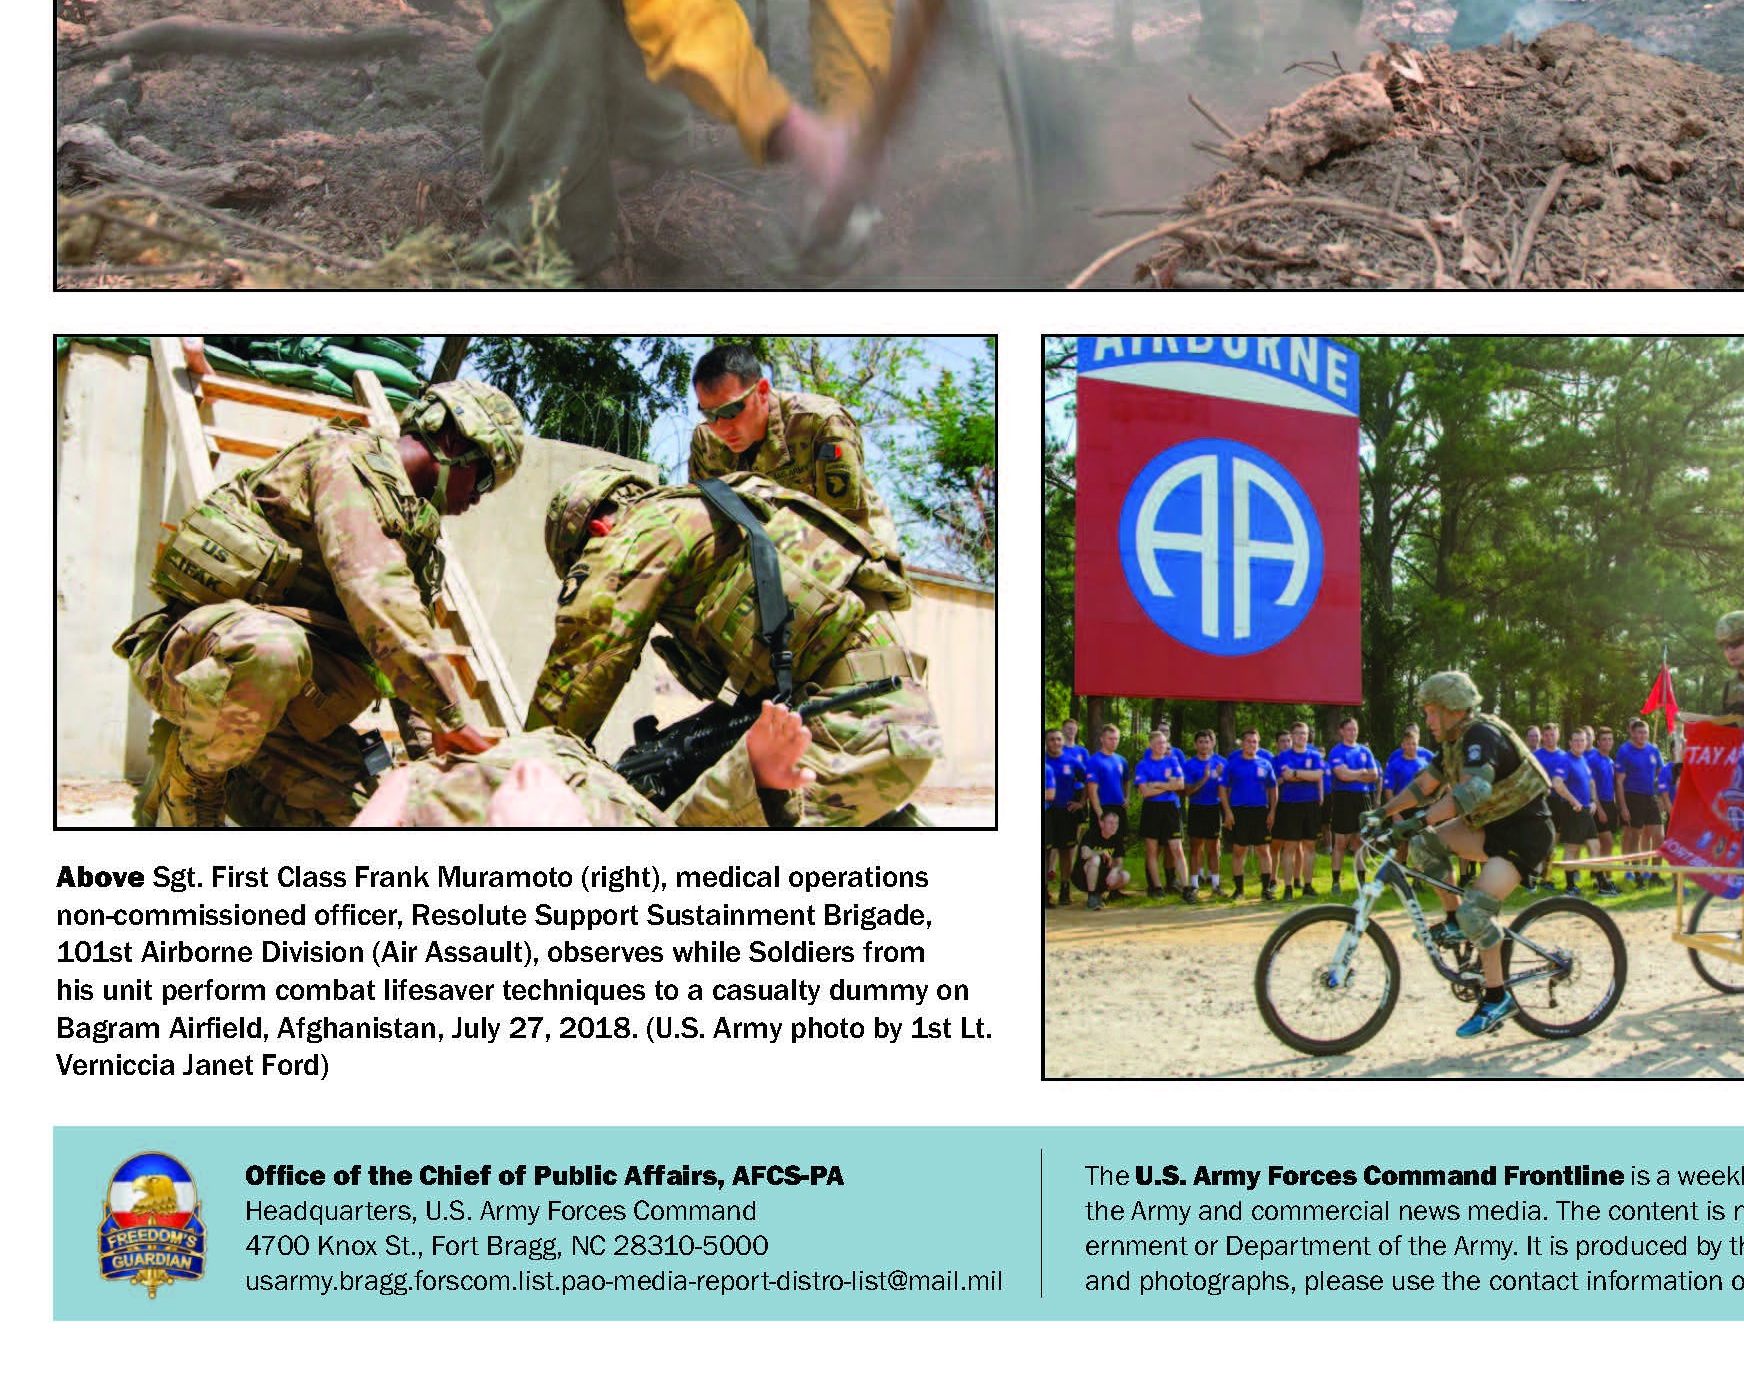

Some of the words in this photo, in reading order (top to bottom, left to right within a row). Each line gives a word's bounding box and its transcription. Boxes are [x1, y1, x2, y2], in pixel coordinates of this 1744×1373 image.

[200, 538, 229, 564] US
[55, 865, 145, 888] Above
[152, 865, 203, 893] Sgt.
[212, 865, 269, 888] First
[277, 865, 347, 888] Class
[355, 865, 430, 888] Frank
[438, 865, 573, 888] Muramoto
[581, 865, 667, 893] (right),
[676, 865, 780, 888] medical
[788, 865, 929, 893] operations
[245, 1164, 326, 1186] Office
[333, 1164, 362, 1186] of
[367, 1165, 413, 1186] the
[419, 1164, 492, 1186] Chief
[498, 1164, 527, 1186] of
[534, 1164, 618, 1186] Public
[623, 1164, 725, 1191] Affairs,
[731, 1164, 845, 1186] AFCS-PA
[1084, 1165, 1130, 1186] The
[1135, 1164, 1187, 1186] U.S.
[1192, 1165, 1262, 1191] Army
[1268, 1165, 1358, 1186] Forces
[1363, 1164, 1497, 1186] Command
[1504, 1164, 1625, 1186] Frontline
[1631, 1165, 1651, 1186] is
[1656, 1169, 1670, 1186] a
[246, 1200, 417, 1226] Headquarters,
[426, 1199, 472, 1221] U.S.
[479, 1200, 541, 1226] Army
[548, 1200, 627, 1221] Forces
[633, 1199, 756, 1221] Command
[107, 1228, 198, 1249] FREEDOM'S
[245, 1234, 310, 1256] 4700
[318, 1235, 378, 1256] Knox
[385, 1234, 423, 1260] St.,
[432, 1235, 480, 1256] Fort
[487, 1235, 562, 1261] Bragg,
[572, 1234, 606, 1256] NC
[613, 1234, 769, 1256] 28310-5000
[111, 1252, 193, 1270] GUARDIAN
[246, 1269, 1002, 1296] usarmy.bragg.forscom.list.pao-media-report-distro-list@mail.mil
